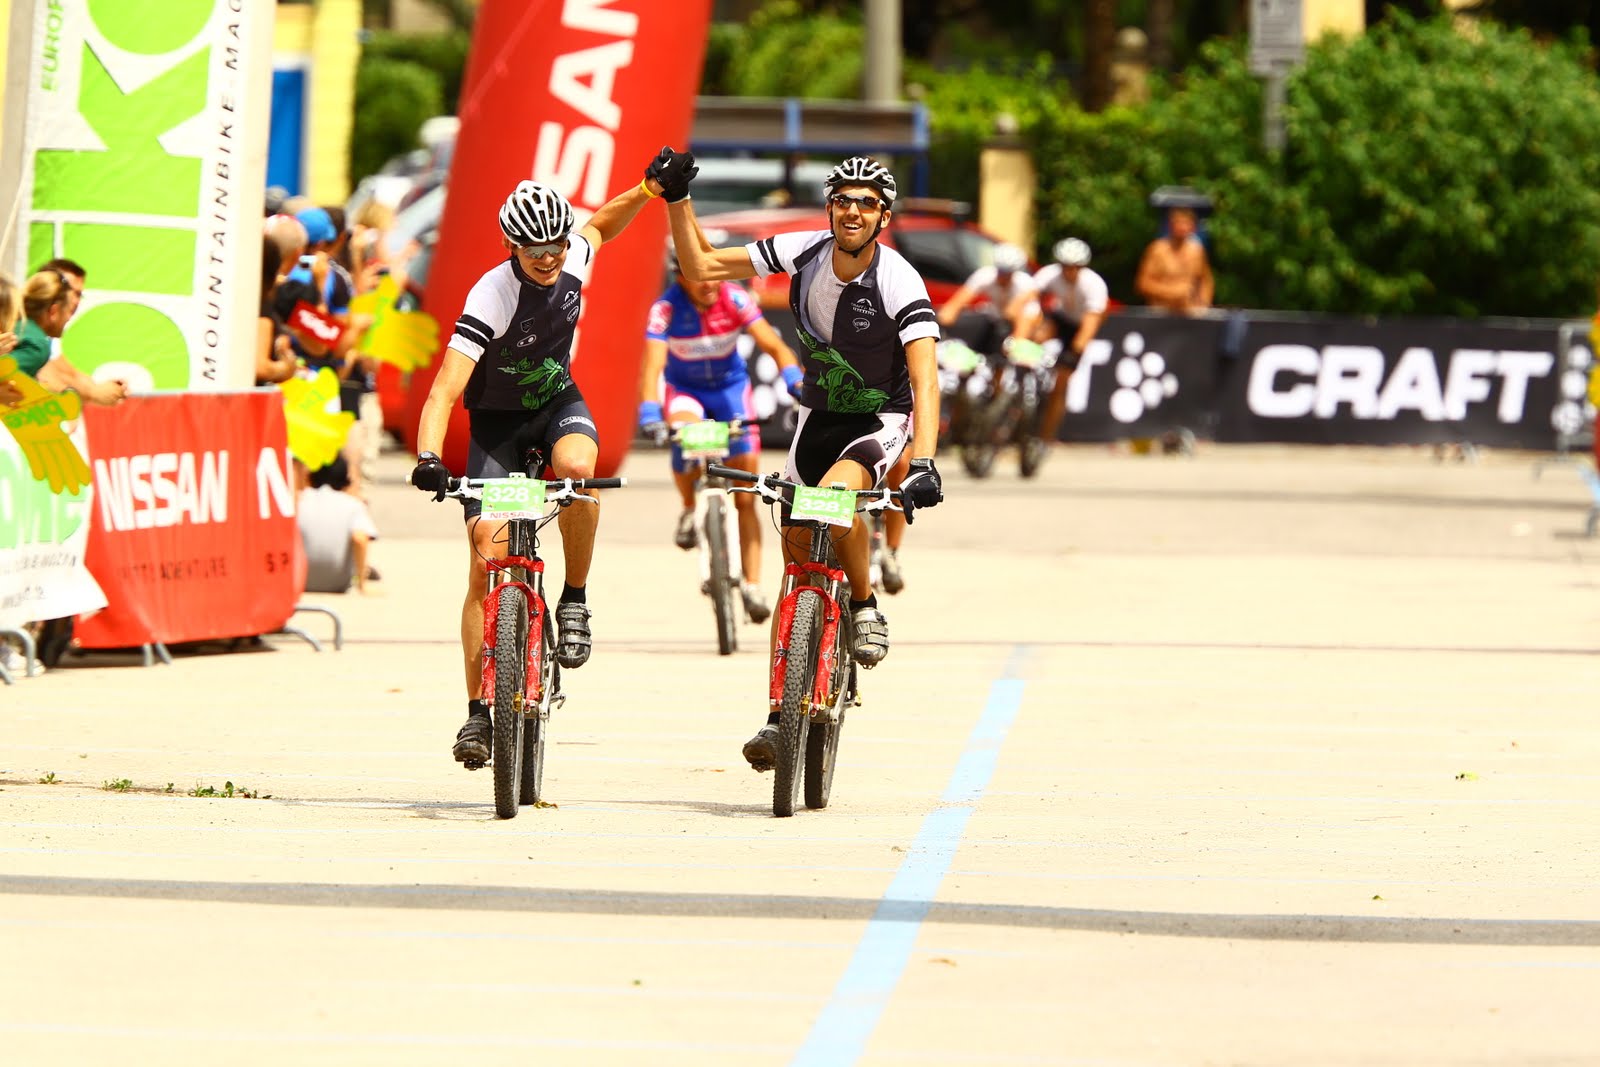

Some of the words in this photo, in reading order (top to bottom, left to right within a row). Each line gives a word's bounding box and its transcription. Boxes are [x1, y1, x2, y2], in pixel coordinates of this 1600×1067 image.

[1246, 343, 1554, 423] CRAFT
[94, 450, 229, 532] NISSAN
[487, 486, 529, 502] 328
[800, 488, 840, 499] CRAFT
[799, 498, 839, 513] 328
